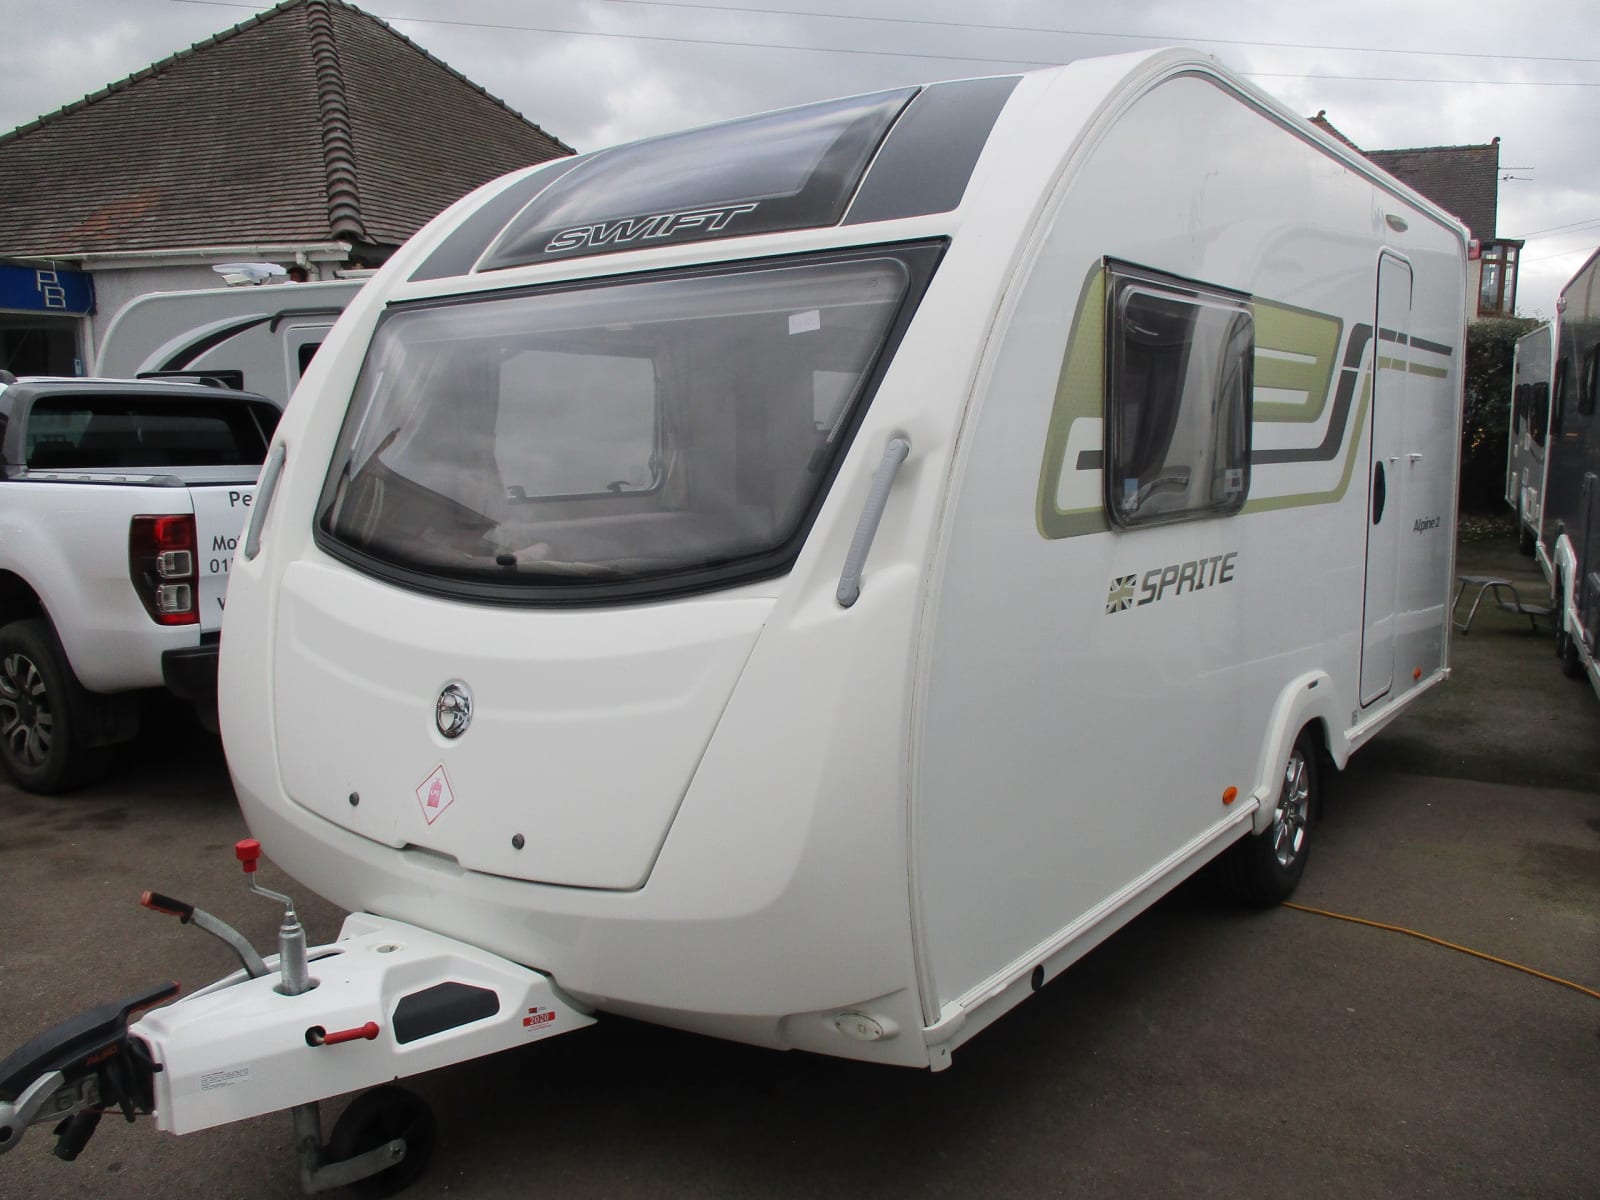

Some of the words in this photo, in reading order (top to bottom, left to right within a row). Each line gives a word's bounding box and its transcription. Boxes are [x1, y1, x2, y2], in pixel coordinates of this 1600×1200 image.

[545, 201, 760, 253] SWIFT
[1412, 516, 1435, 534] Alpine
[212, 535, 240, 551] Mo
[209, 557, 233, 573] 01
[1137, 551, 1238, 606] SPRITE
[529, 1013, 549, 1025] 2020
